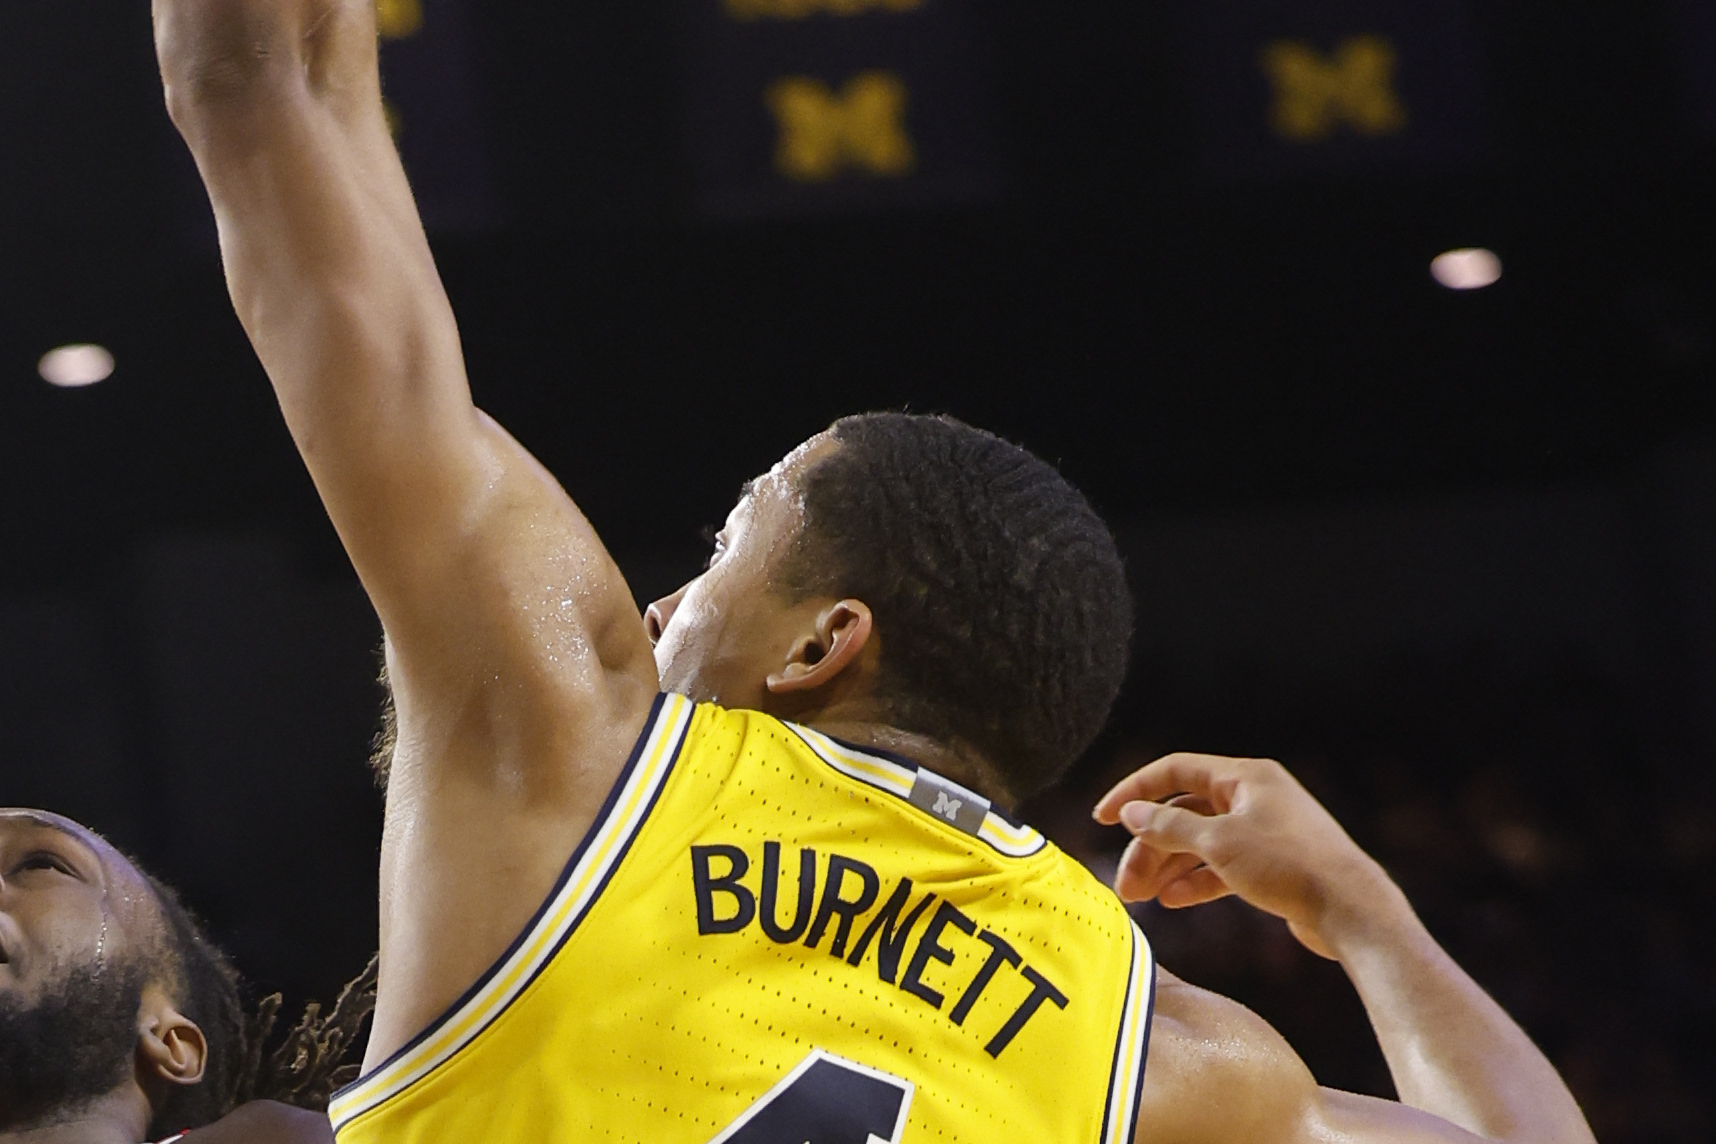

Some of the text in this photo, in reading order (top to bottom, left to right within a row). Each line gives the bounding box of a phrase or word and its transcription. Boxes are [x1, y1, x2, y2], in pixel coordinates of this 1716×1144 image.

[765, 72, 911, 178] M
[932, 790, 962, 821] M
[689, 840, 1069, 1059] BURNETT
